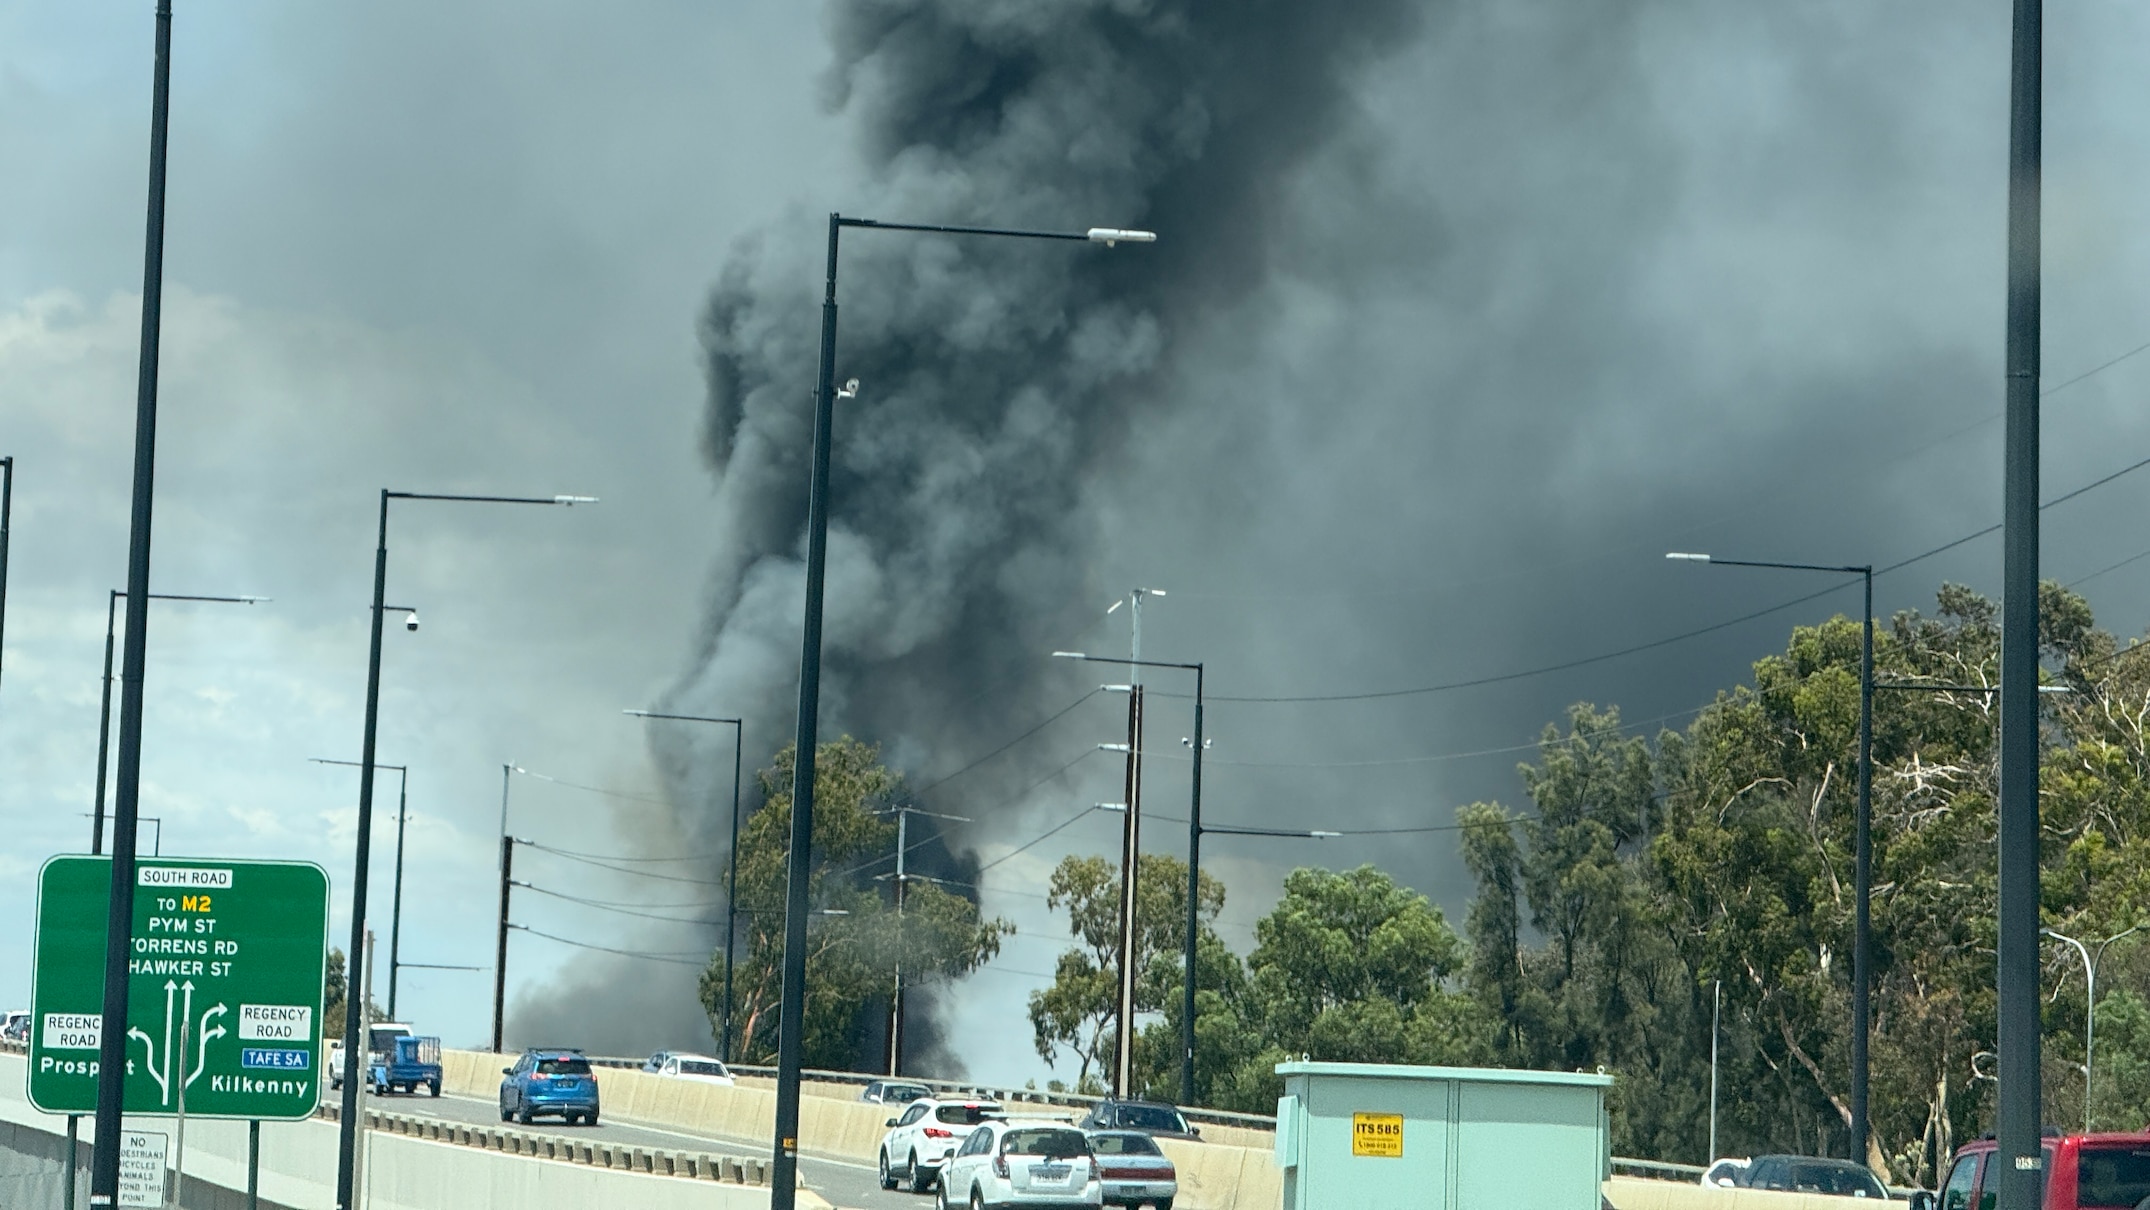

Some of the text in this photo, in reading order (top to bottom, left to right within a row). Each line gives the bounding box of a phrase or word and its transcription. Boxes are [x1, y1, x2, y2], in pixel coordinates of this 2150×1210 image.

[144, 871, 227, 884] SOUTH ROAD
[157, 895, 211, 912] TO M2
[149, 917, 216, 934] PYM ST
[215, 941, 238, 955] RD
[129, 959, 232, 977] HAWKER ST
[245, 1008, 306, 1022] REGENCY
[49, 1017, 101, 1030] REGENC
[257, 1025, 292, 1038] ROAD
[61, 1034, 96, 1047] ROAD
[249, 1052, 303, 1067] TAFE SA
[41, 1056, 135, 1078] Prospt
[212, 1075, 308, 1099] Kilkenny
[1356, 1123, 1375, 1134] ITS
[131, 1137, 146, 1148] NO
[120, 1150, 164, 1160] DESTRIANS
[119, 1182, 141, 1191] YOND
